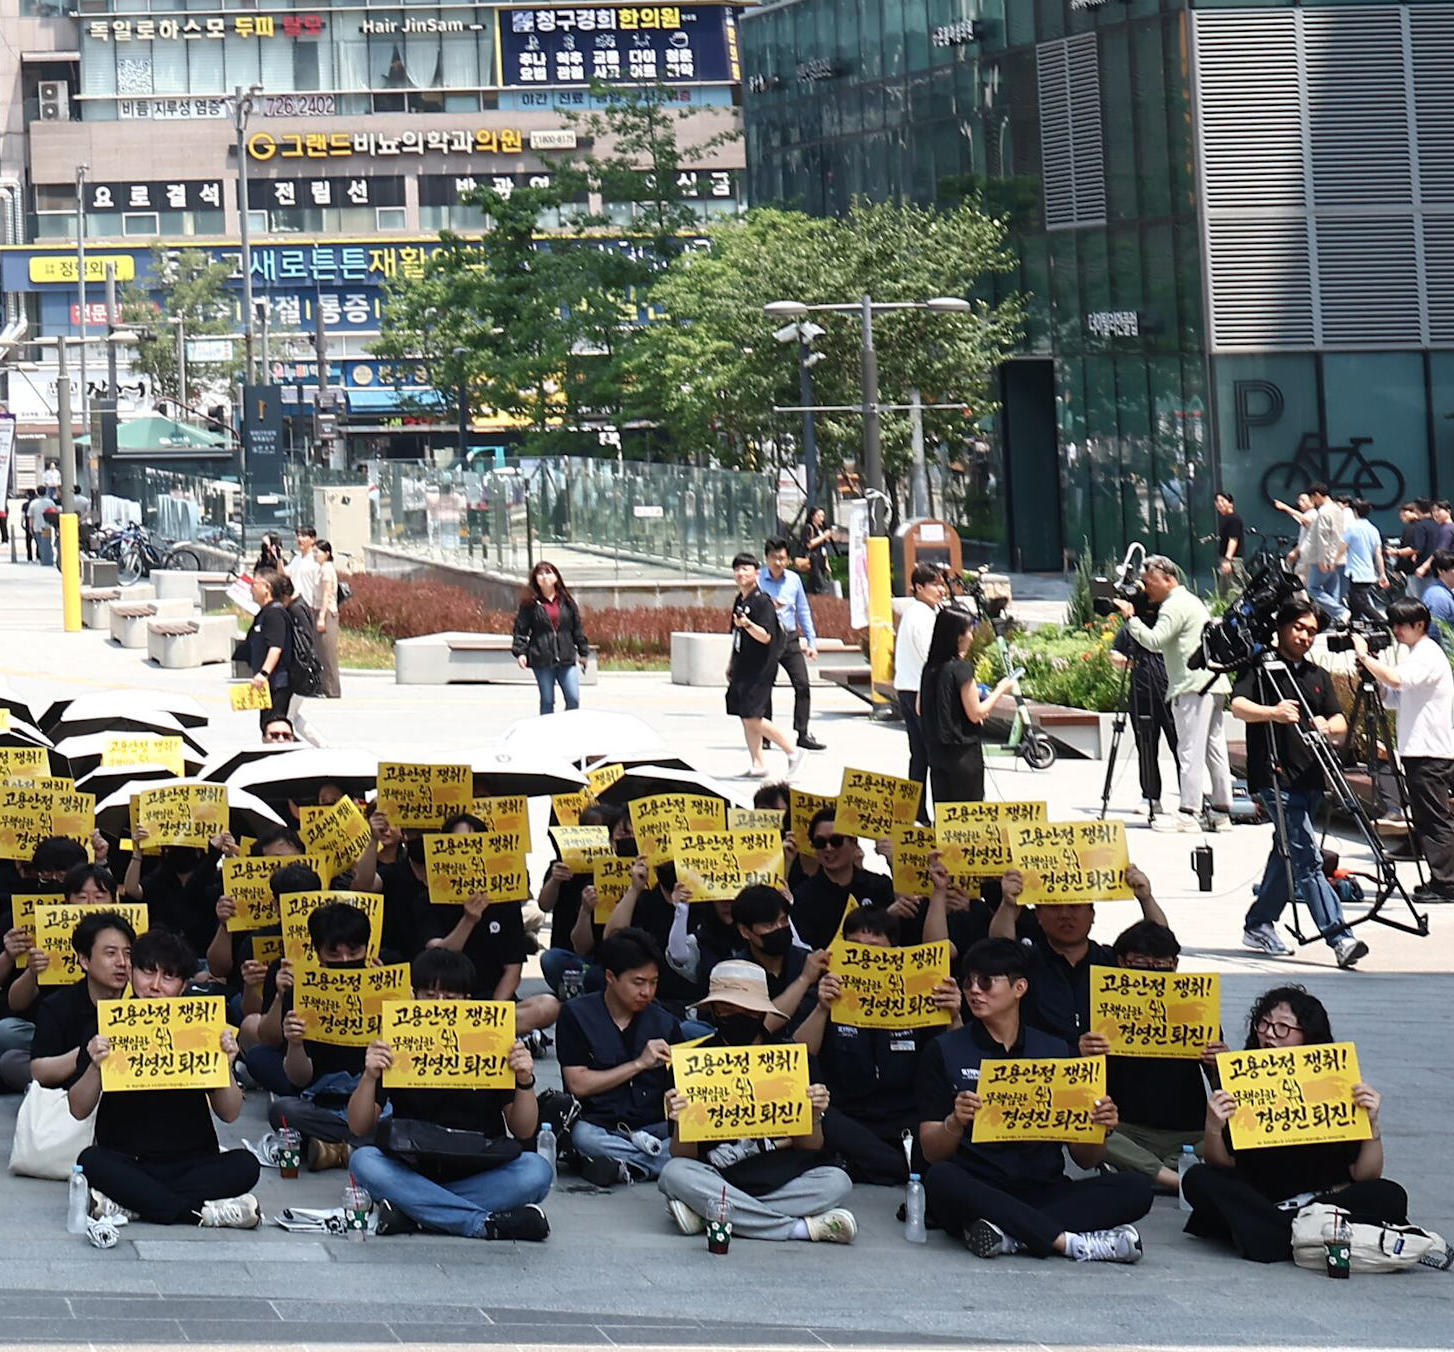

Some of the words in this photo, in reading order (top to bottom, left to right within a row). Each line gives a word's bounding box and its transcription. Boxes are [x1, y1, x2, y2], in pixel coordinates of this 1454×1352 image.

[89, 18, 225, 42] 독일로하스모
[234, 16, 275, 38] 두피
[362, 19, 398, 35] Hair
[401, 17, 463, 34] JinSam
[618, 7, 682, 30] 한의원
[120, 100, 151, 119] 비듬
[281, 129, 524, 159] 그랜드비뇨의학과의원
[93, 183, 221, 208] 요로결석
[274, 179, 369, 205] 전립선
[1233, 379, 1286, 451] P
[145, 787, 189, 804] 고용안정
[157, 820, 191, 837] 경영진
[1018, 825, 1074, 847] 고용안정
[1080, 824, 1116, 844] 쟁취!
[431, 835, 482, 856] 고용안정
[488, 834, 519, 852] 쟁취!
[432, 862, 466, 876] 무책임한
[1020, 855, 1058, 870] 무책임한
[449, 875, 487, 895] 경영진
[489, 874, 521, 892] 퇴진!
[1039, 870, 1084, 892] 경영진
[1086, 869, 1124, 891] 퇴진!
[107, 1002, 170, 1027] 고용안정
[177, 1001, 216, 1023] 쟁취!
[392, 1005, 457, 1027] 고용안정
[465, 1005, 506, 1026] 쟁취!
[107, 1035, 149, 1051] 무책임한
[391, 1035, 434, 1051] 무책임한
[127, 1052, 175, 1077] 경영진
[177, 1051, 219, 1075] 퇴진!
[410, 1052, 459, 1076] 경영진
[462, 1054, 507, 1077] 퇴진!
[1228, 1051, 1295, 1081] 고용안정
[1302, 1048, 1346, 1073] 쟁취!
[1231, 1088, 1276, 1107] 무책임한
[1255, 1104, 1309, 1132] 경영진
[1311, 1102, 1358, 1128] 퇴진!
